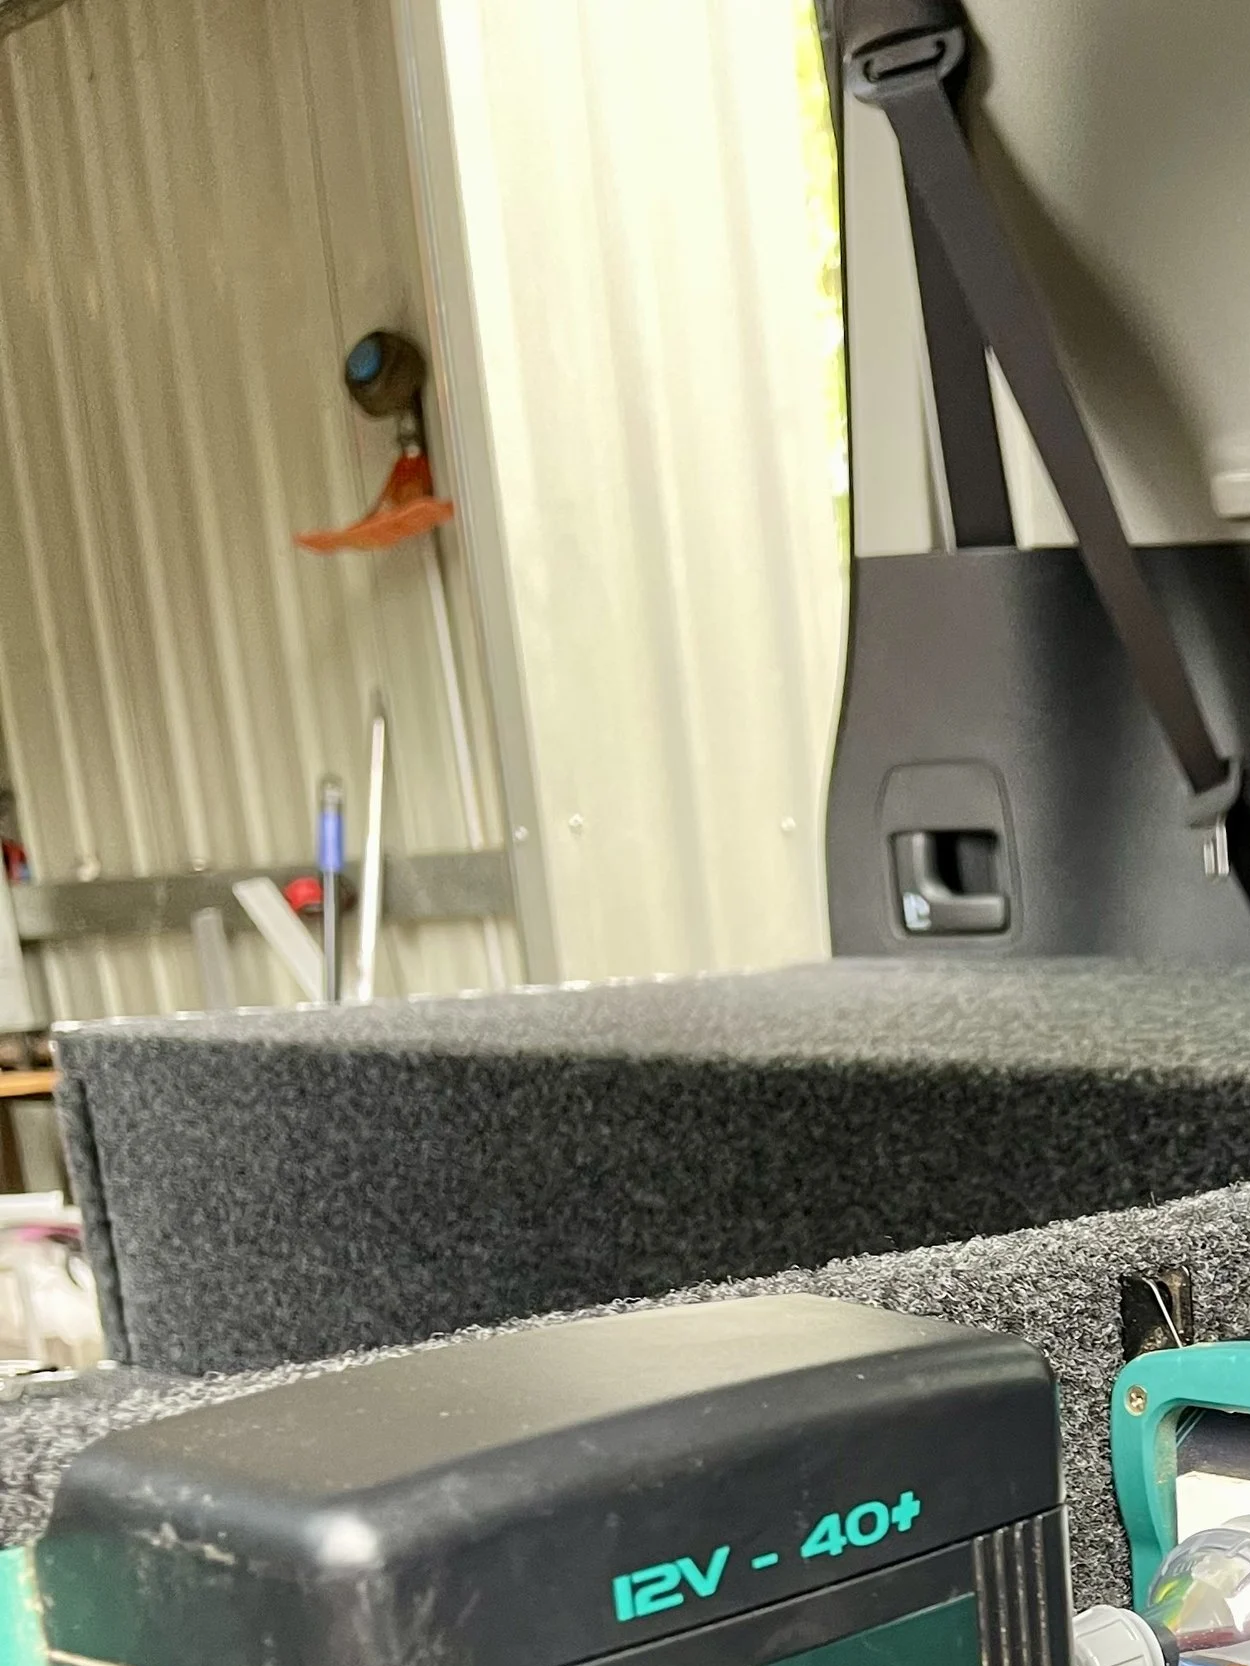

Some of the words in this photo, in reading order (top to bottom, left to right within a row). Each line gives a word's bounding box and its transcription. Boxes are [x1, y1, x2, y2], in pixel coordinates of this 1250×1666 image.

[612, 1546, 730, 1622] 12V
[751, 1551, 779, 1570] -
[801, 1491, 921, 1560] 40+
